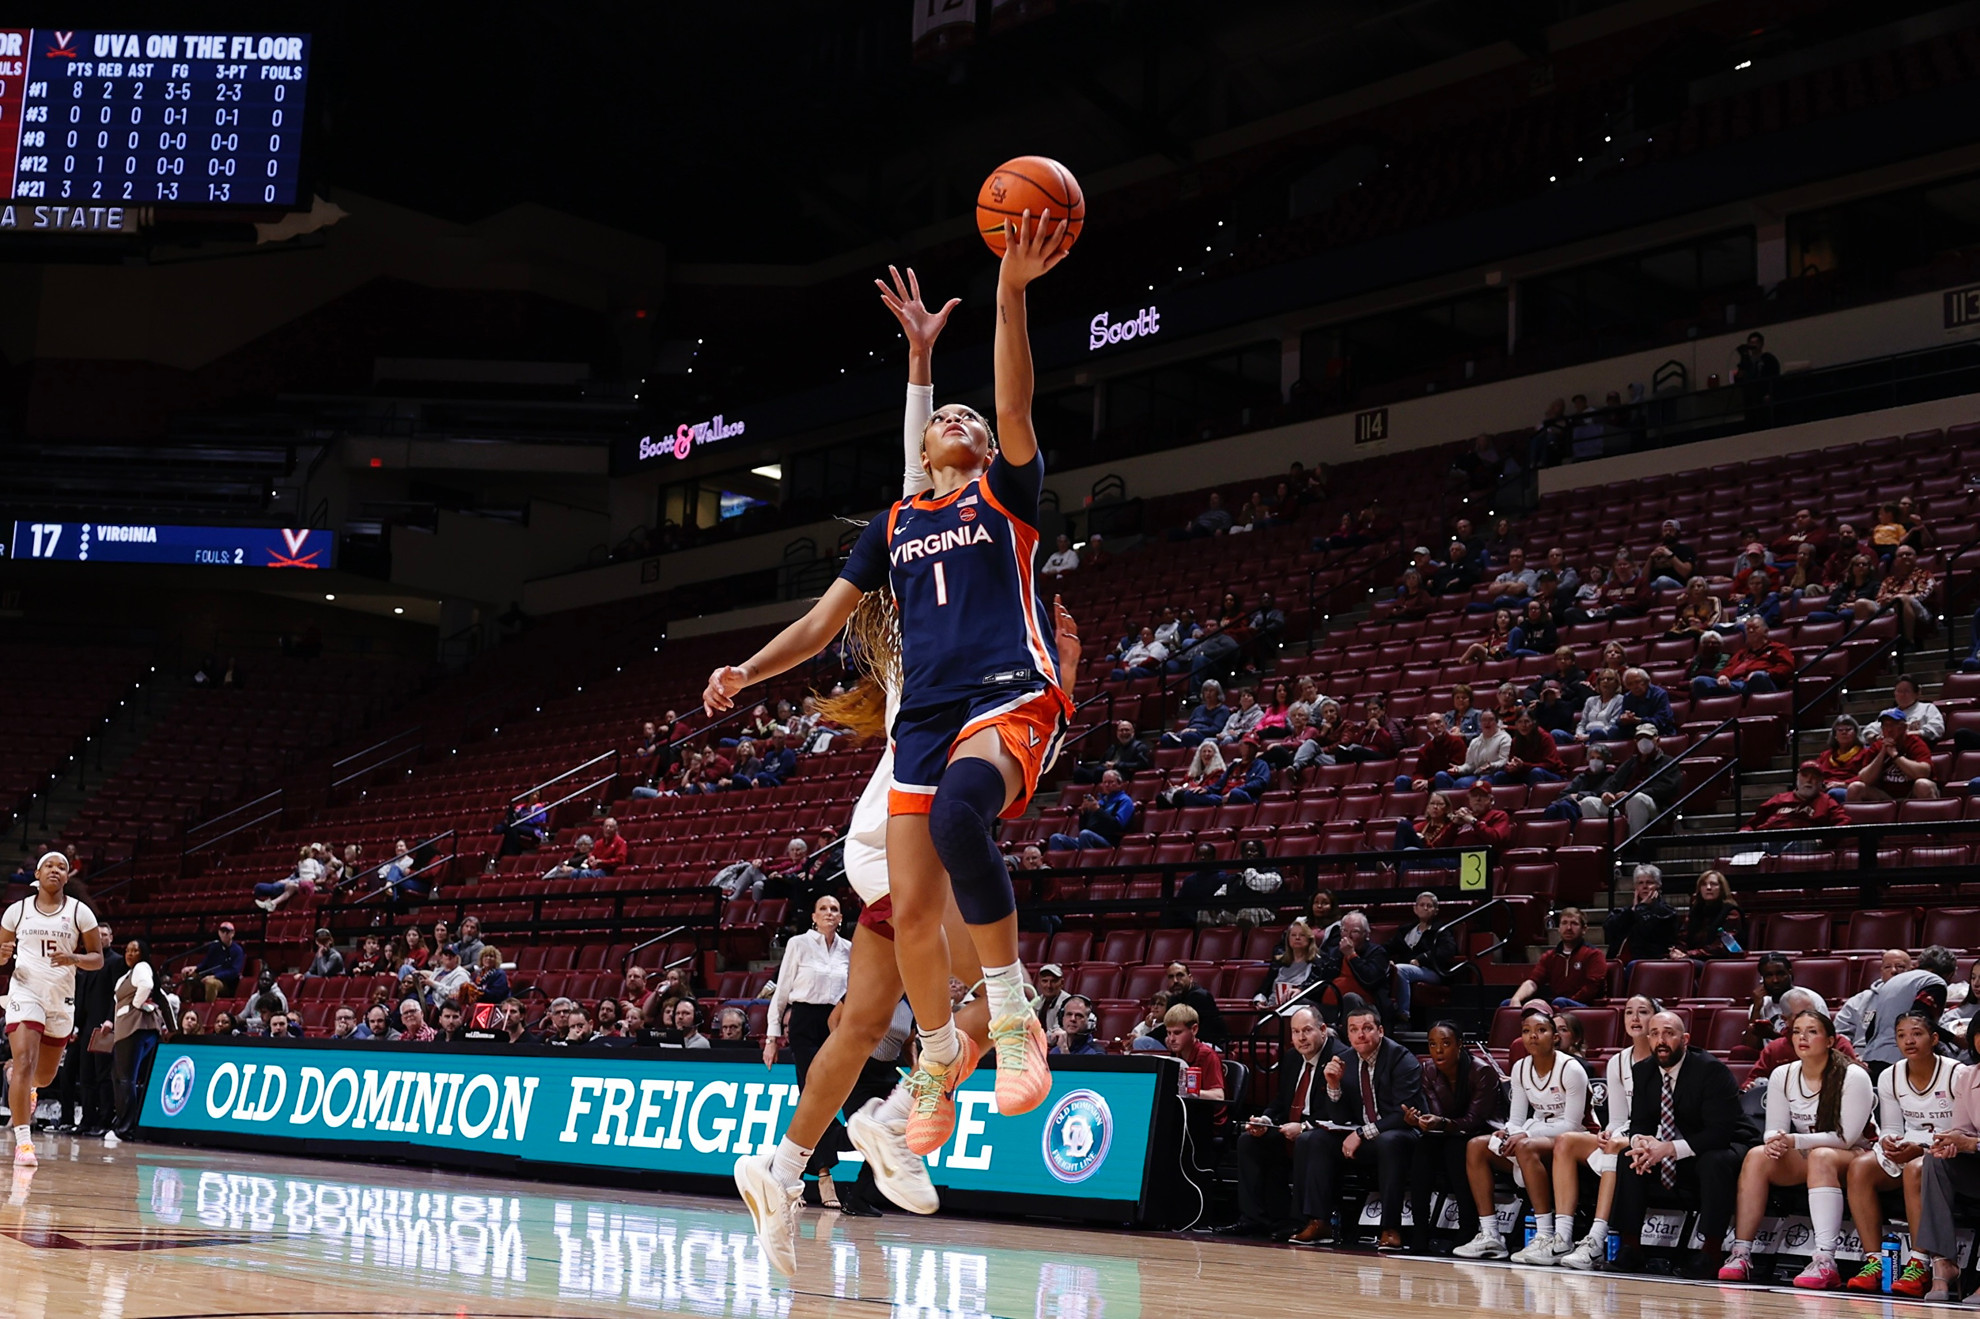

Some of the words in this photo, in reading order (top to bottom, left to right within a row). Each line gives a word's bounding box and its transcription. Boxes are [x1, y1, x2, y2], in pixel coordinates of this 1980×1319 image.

[94, 34, 140, 58] UVA
[146, 34, 177, 58] ON
[184, 35, 227, 59] THE
[230, 36, 303, 60] FLOOR
[67, 62, 93, 77] PTS
[97, 63, 123, 77] REB
[128, 63, 154, 78] AST
[171, 63, 189, 78] FG
[216, 64, 247, 79] 3-PT
[261, 65, 303, 80] FOULS
[28, 81, 48, 98] #1
[73, 81, 83, 98] 8
[103, 82, 113, 99] 2
[133, 82, 143, 99] 2
[164, 82, 191, 100] 3-5
[216, 83, 242, 101] 2-3
[274, 84, 285, 102] 0
[25, 106, 48, 123] #3
[70, 105, 80, 123] 0
[100, 106, 111, 124] 0
[131, 106, 141, 124] 0
[164, 107, 187, 125] 0-1
[215, 108, 239, 126] 0-1
[272, 109, 282, 127] 0
[23, 131, 45, 147] #8
[67, 130, 77, 148] 0
[97, 131, 108, 149] 0
[128, 131, 139, 149] 0
[160, 132, 187, 150] 0-0
[211, 133, 238, 151] 0-0
[269, 134, 280, 152] 0
[20, 156, 48, 172] #12
[64, 155, 75, 173] 0
[97, 156, 103, 174] 1
[125, 156, 136, 174] 0
[157, 157, 184, 175] 0-0
[208, 158, 236, 176] 0-0
[267, 159, 277, 177] 0
[17, 181, 45, 198] #21
[61, 180, 71, 198] 3
[92, 181, 101, 199] 2
[122, 181, 132, 199] 2
[157, 182, 178, 200] 1-3
[208, 183, 230, 201] 1-3
[264, 184, 275, 202] 0
[33, 205, 124, 228] STATE
[1089, 306, 1160, 351] Scott
[639, 436, 675, 460] Scott
[691, 414, 745, 446] Wallace
[1361, 412, 1383, 440] 114
[30, 523, 62, 558] 17
[97, 525, 157, 543] VIRGINIA
[195, 549, 230, 564] FOULS:
[234, 548, 244, 564] 2
[889, 523, 994, 568] VIRGINIA
[933, 561, 948, 606] 1
[1466, 853, 1481, 886] 3
[52, 930, 72, 939] STATE
[40, 939, 57, 957] 15
[206, 1061, 287, 1121] OLD
[289, 1066, 540, 1141] DOMINION
[558, 1075, 800, 1155] FREIGH
[1055, 1107, 1071, 1125] OLD
[1547, 1102, 1566, 1111] STAT
[1052, 1149, 1079, 1171] FREIGHT
[1079, 1151, 1097, 1169] LINE
